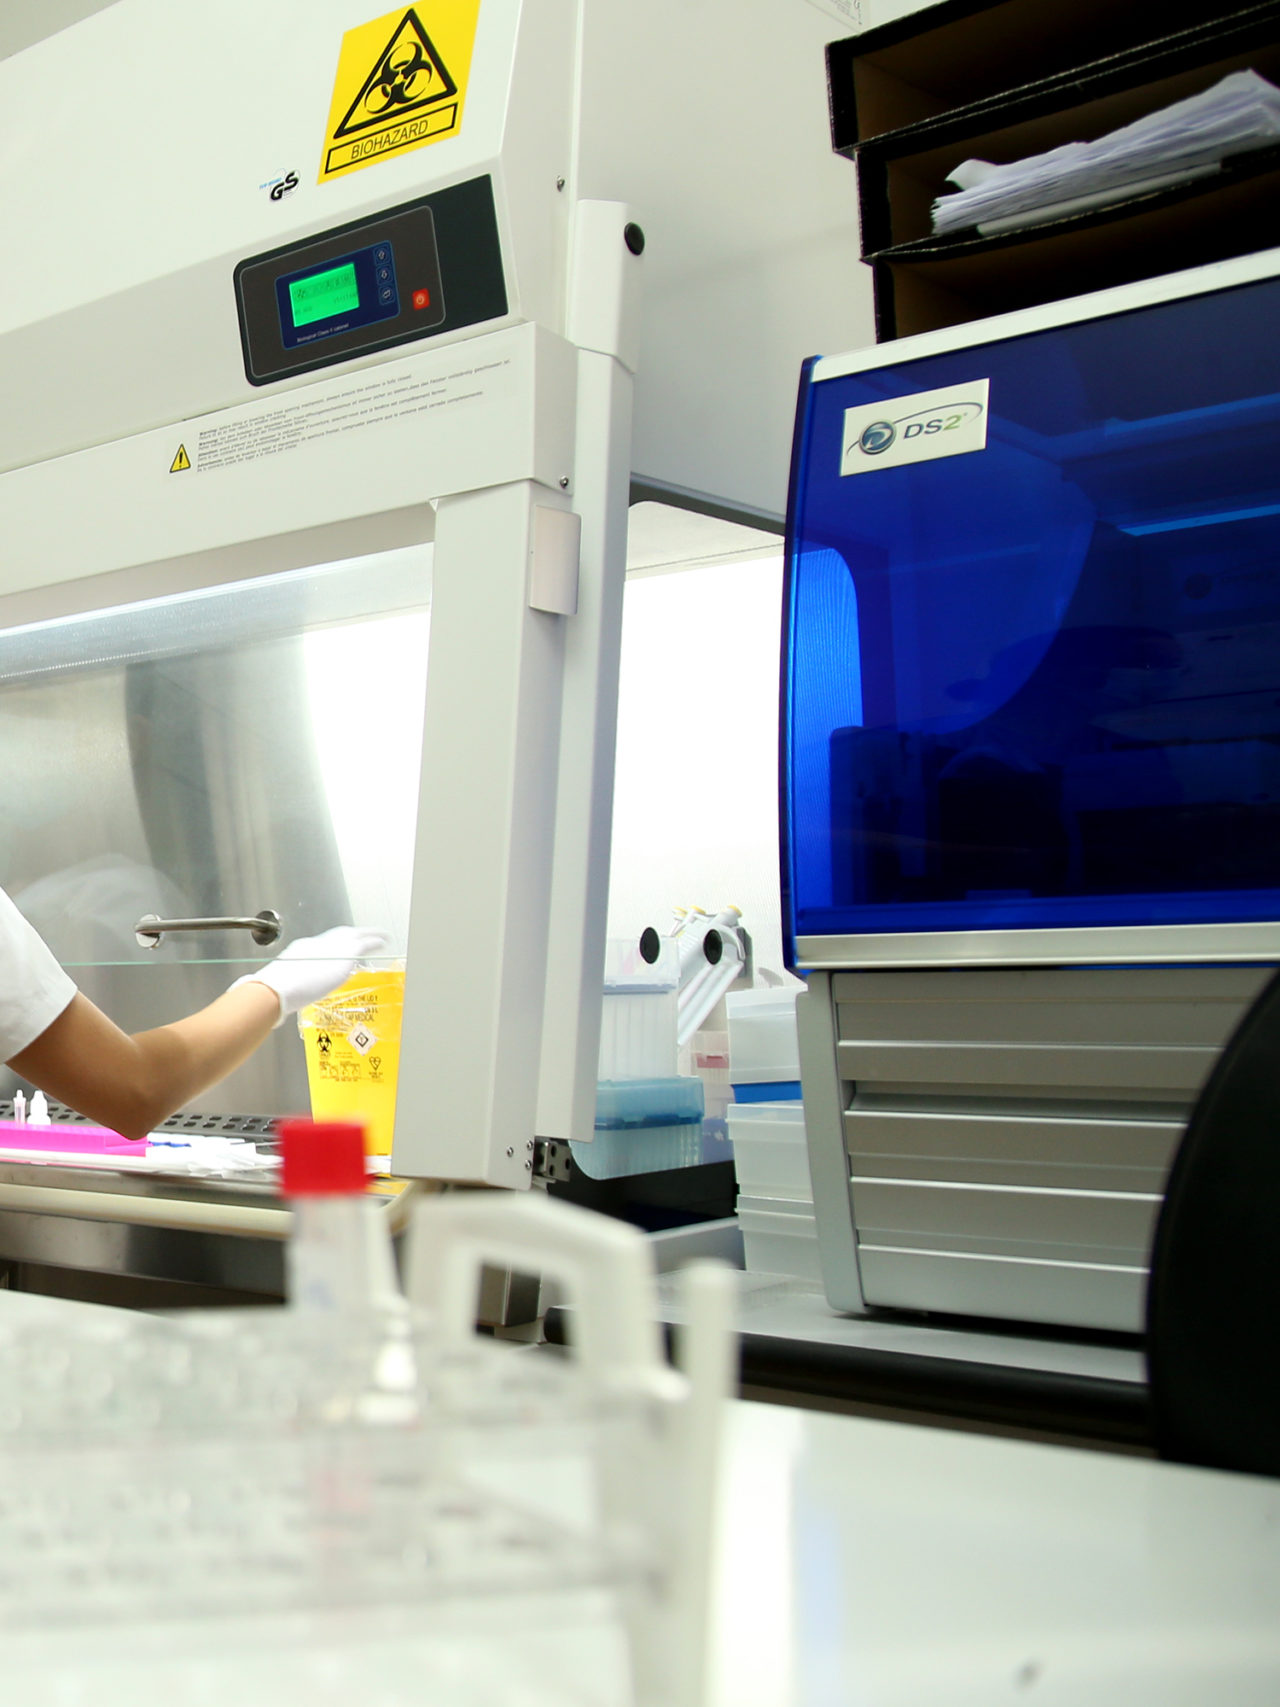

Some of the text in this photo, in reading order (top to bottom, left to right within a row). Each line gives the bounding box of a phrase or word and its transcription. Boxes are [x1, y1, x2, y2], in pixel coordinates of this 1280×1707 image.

[351, 119, 429, 160] BIOHAZARD
[270, 169, 299, 201] GS
[903, 414, 963, 440] DS2
